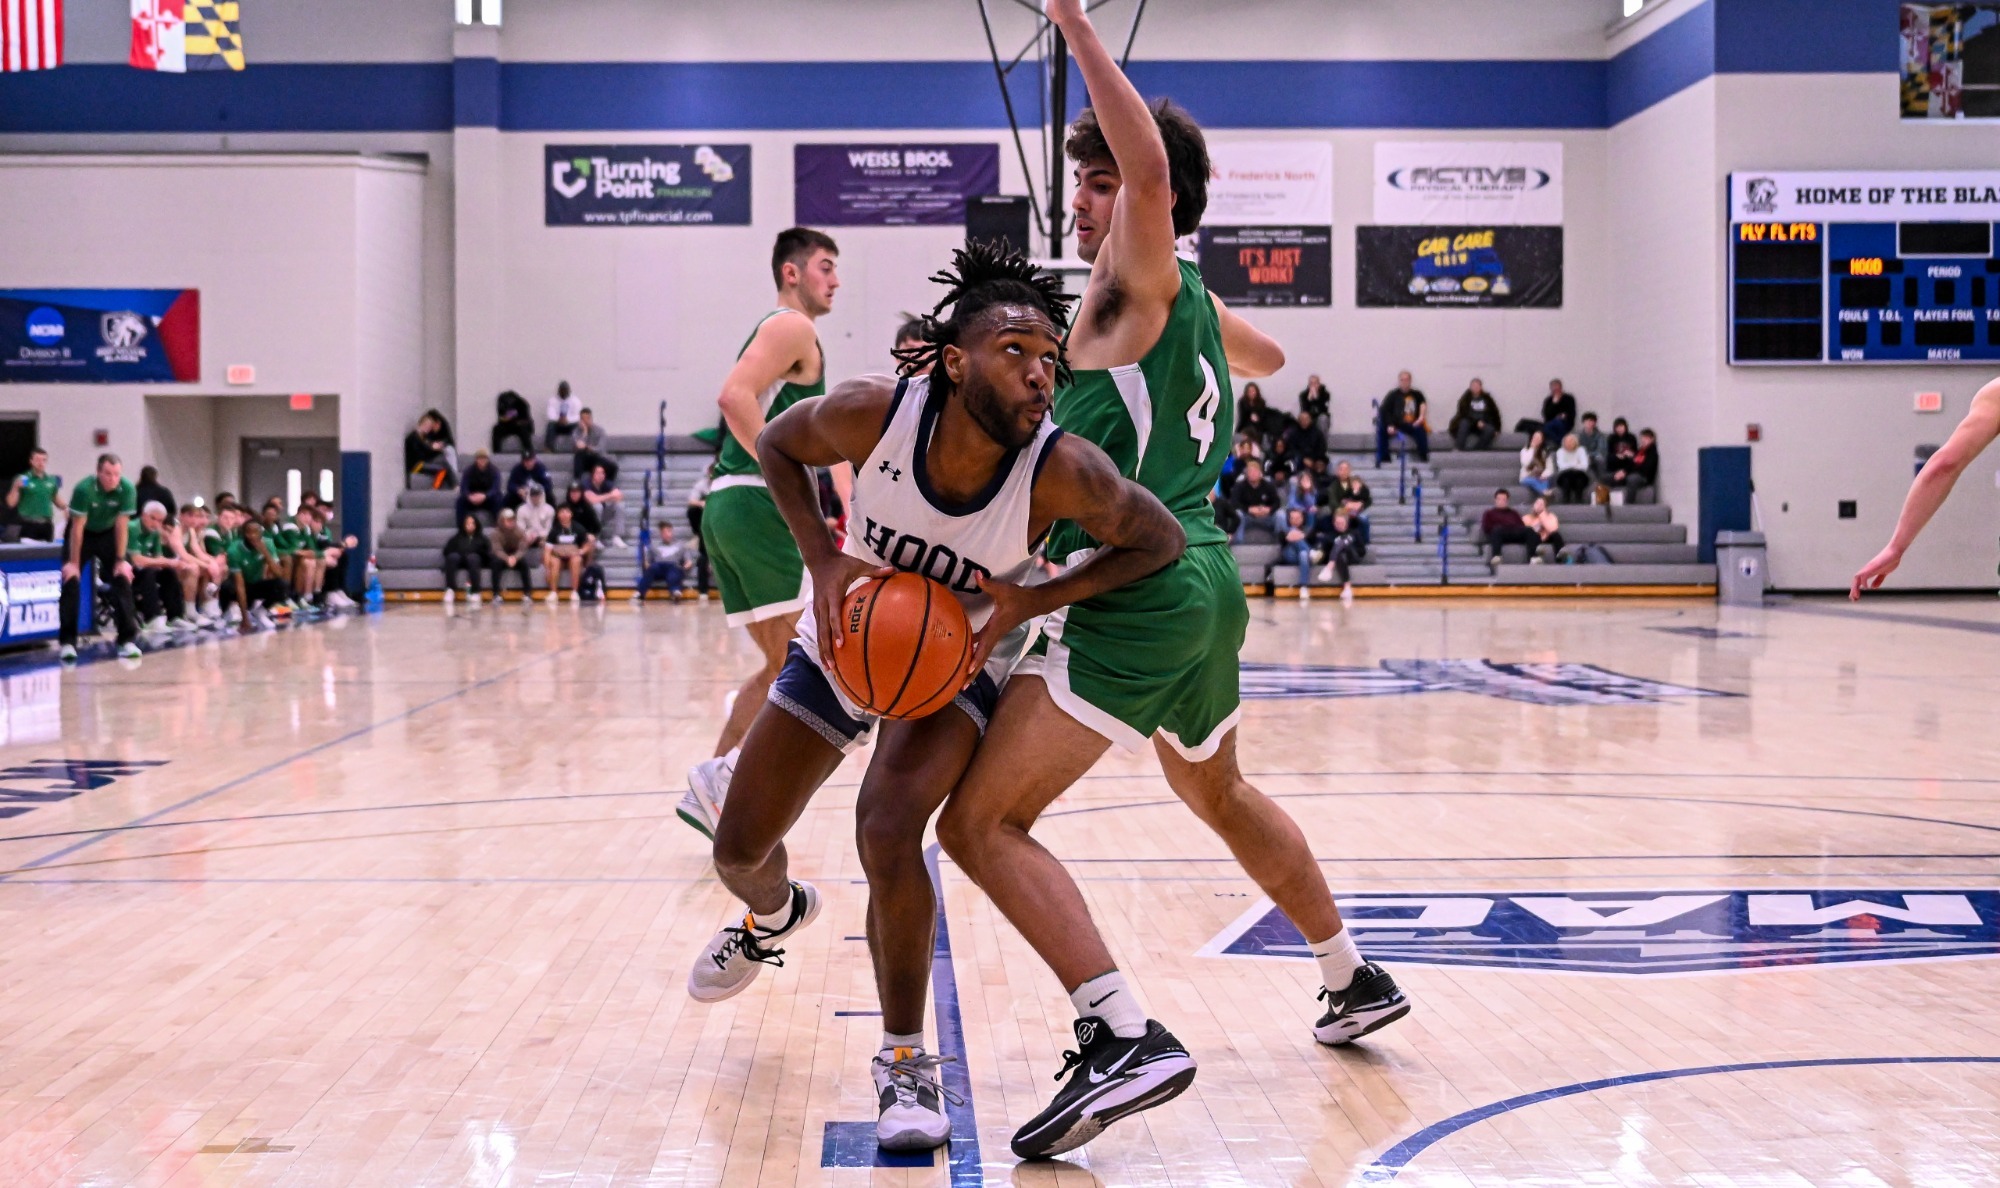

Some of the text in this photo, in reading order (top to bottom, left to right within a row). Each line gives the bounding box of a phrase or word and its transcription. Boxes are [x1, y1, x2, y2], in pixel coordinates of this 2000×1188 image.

[847, 152, 952, 167] WEISS BROS.
[591, 157, 681, 185] Turning
[1228, 170, 1315, 180] Frederick North
[1411, 167, 1526, 184] ACTIVE
[596, 178, 655, 198] Point
[1796, 187, 2000, 204] HOME OF THE BLA
[584, 209, 713, 225] www.tpfinancial.com
[1790, 222, 1816, 240] PTS
[1418, 230, 1495, 256] CAR CARE
[1239, 247, 1302, 267] IT'S JUST
[1249, 266, 1294, 284] WORK!
[1850, 258, 1882, 275] HOOD
[1928, 266, 1961, 278] PERIOD
[1839, 309, 1869, 321] FOULS
[1914, 309, 1974, 321] PLAYER FOUL
[1841, 348, 1863, 360] WON
[1928, 348, 1960, 360] MATCH
[1186, 351, 1220, 464] 4
[863, 516, 992, 595] HOOD
[850, 595, 867, 633] ROCK
